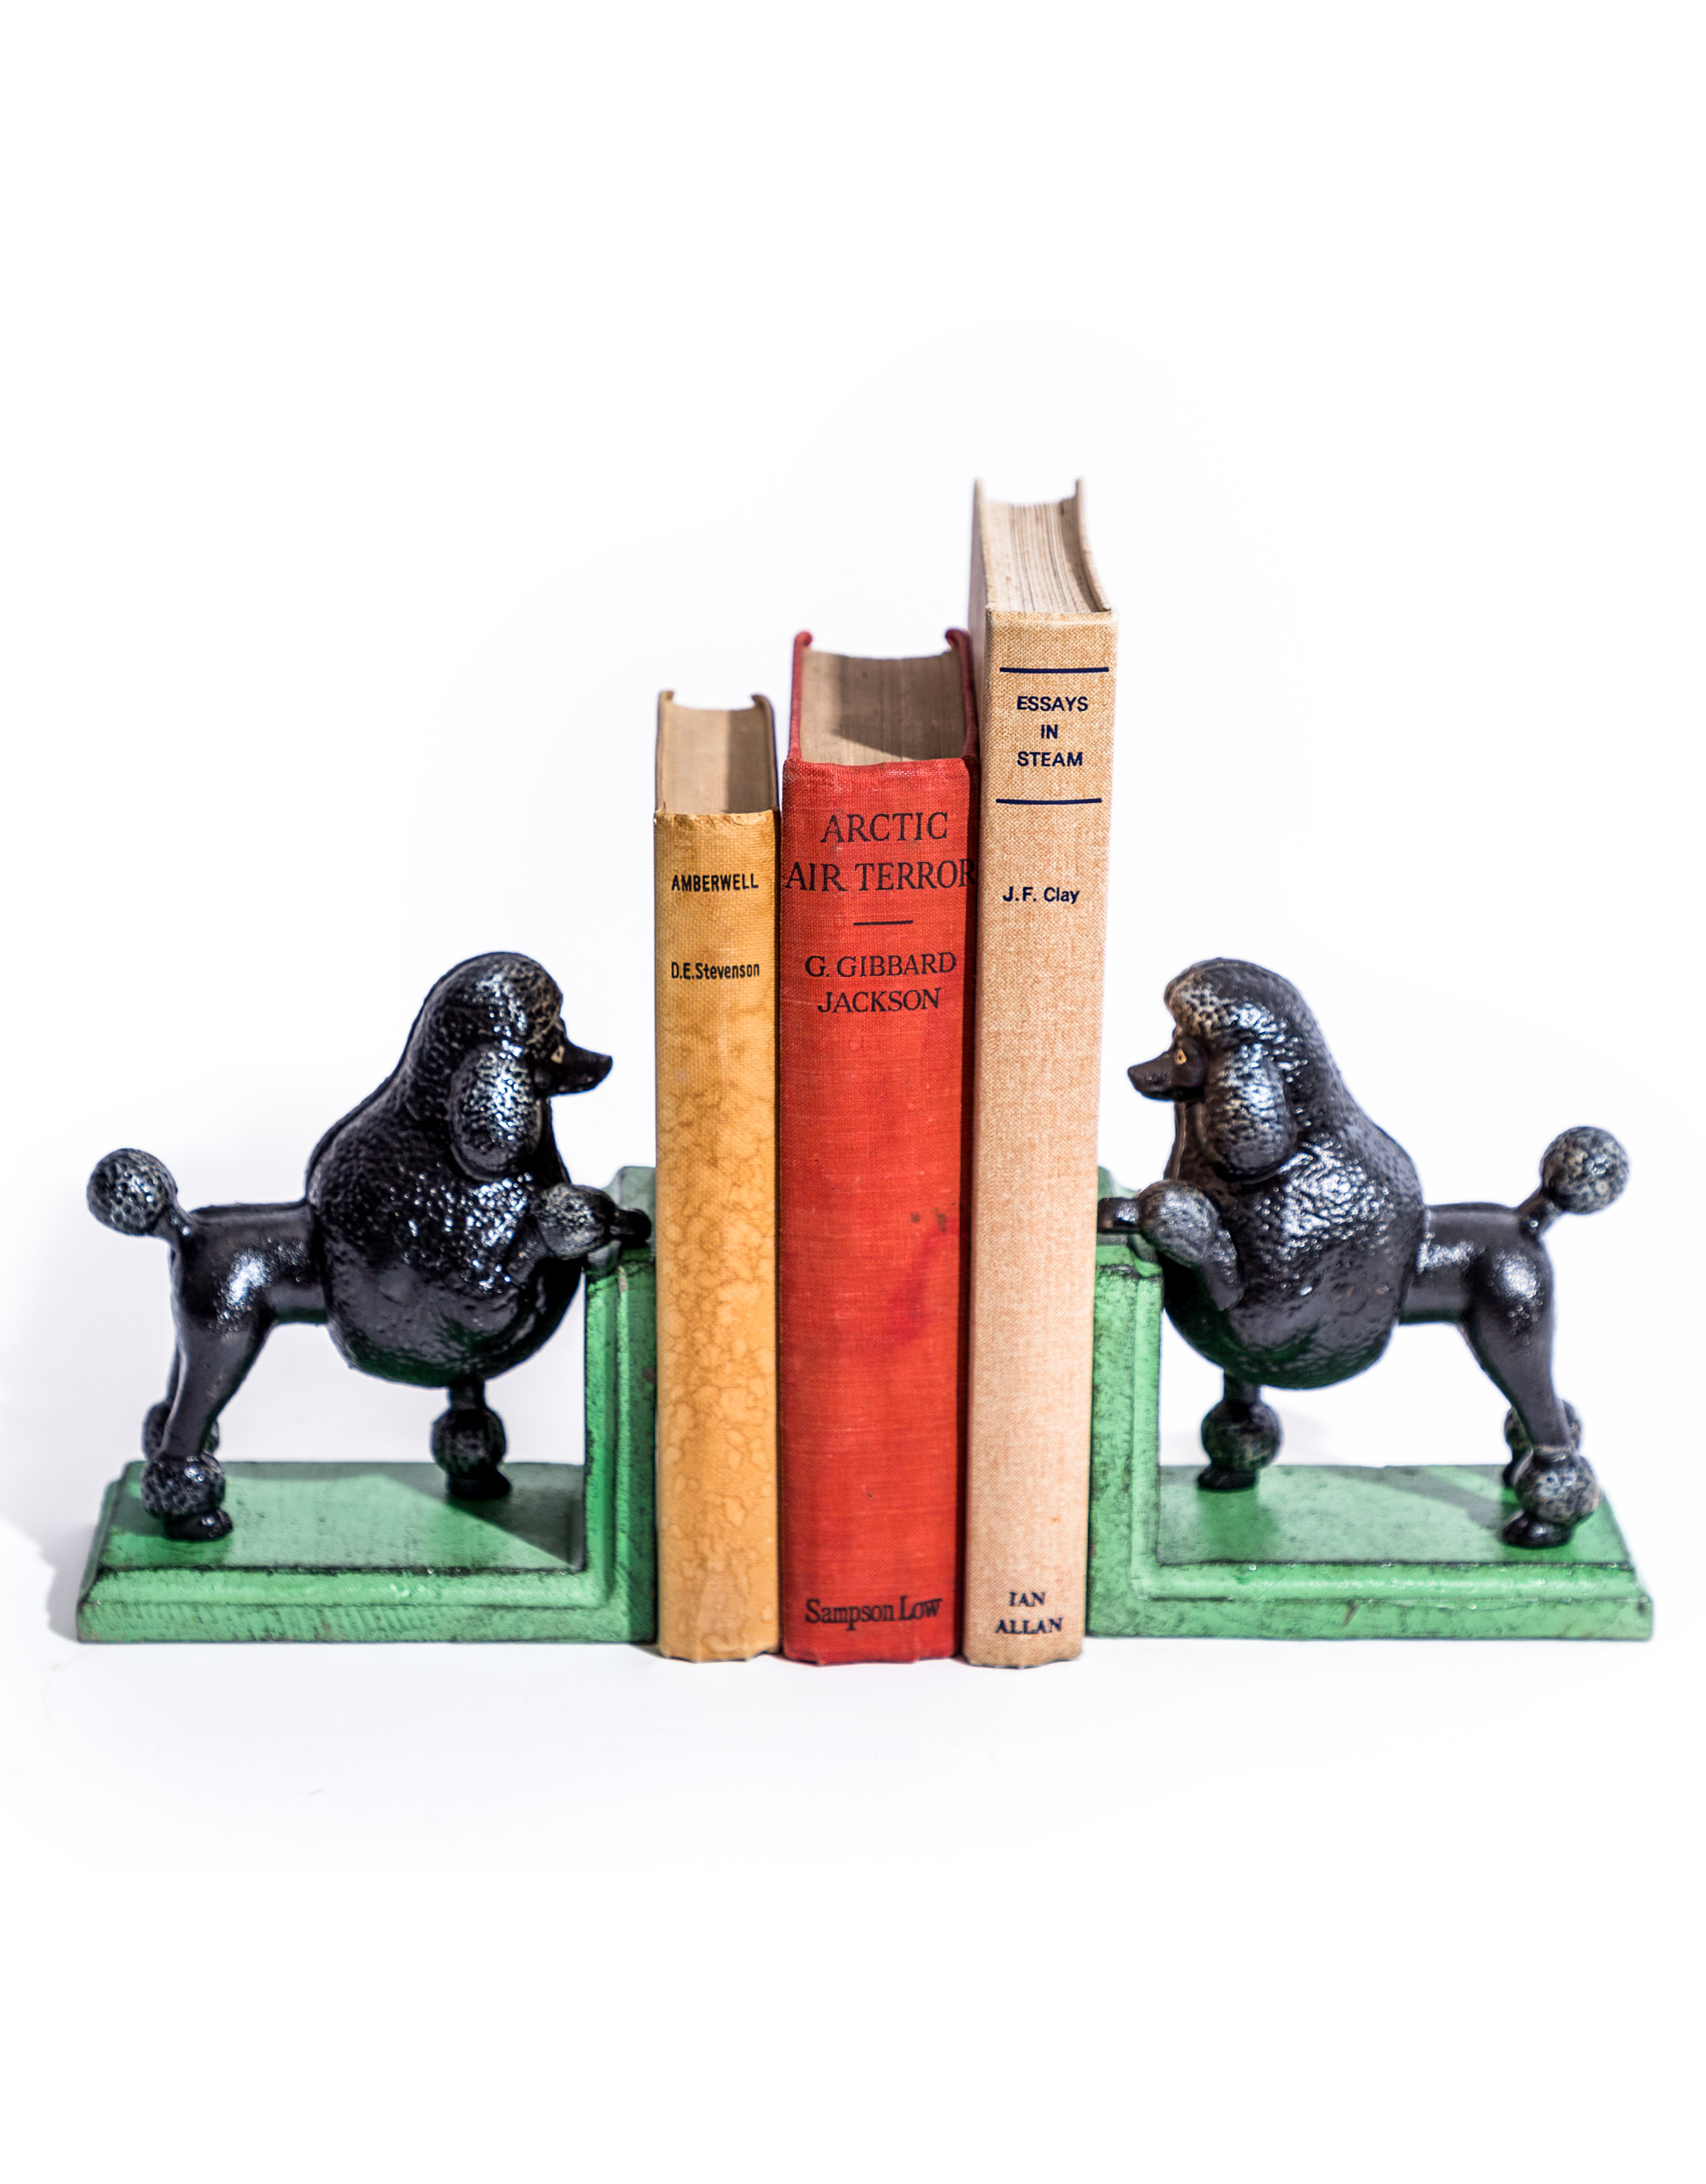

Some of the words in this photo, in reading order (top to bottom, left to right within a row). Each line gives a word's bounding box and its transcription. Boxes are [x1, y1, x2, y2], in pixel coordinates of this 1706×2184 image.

[1017, 695, 1089, 712] ESSAYS
[1041, 724, 1058, 739] IN
[1017, 751, 1083, 767] STEAM
[820, 812, 948, 843] ARCTIC
[671, 873, 759, 892] AMBERWELL
[785, 861, 849, 893] AIR
[854, 858, 976, 891] TERROR
[1044, 887, 1080, 904] Clay
[804, 955, 830, 978] G.
[836, 951, 957, 978] GIBBARD
[817, 987, 941, 1013] JACKSON
[1009, 1591, 1046, 1607] IAN
[805, 1599, 894, 1631] Sampson
[898, 1595, 943, 1621] Low
[994, 1617, 1063, 1635] ALLAN
